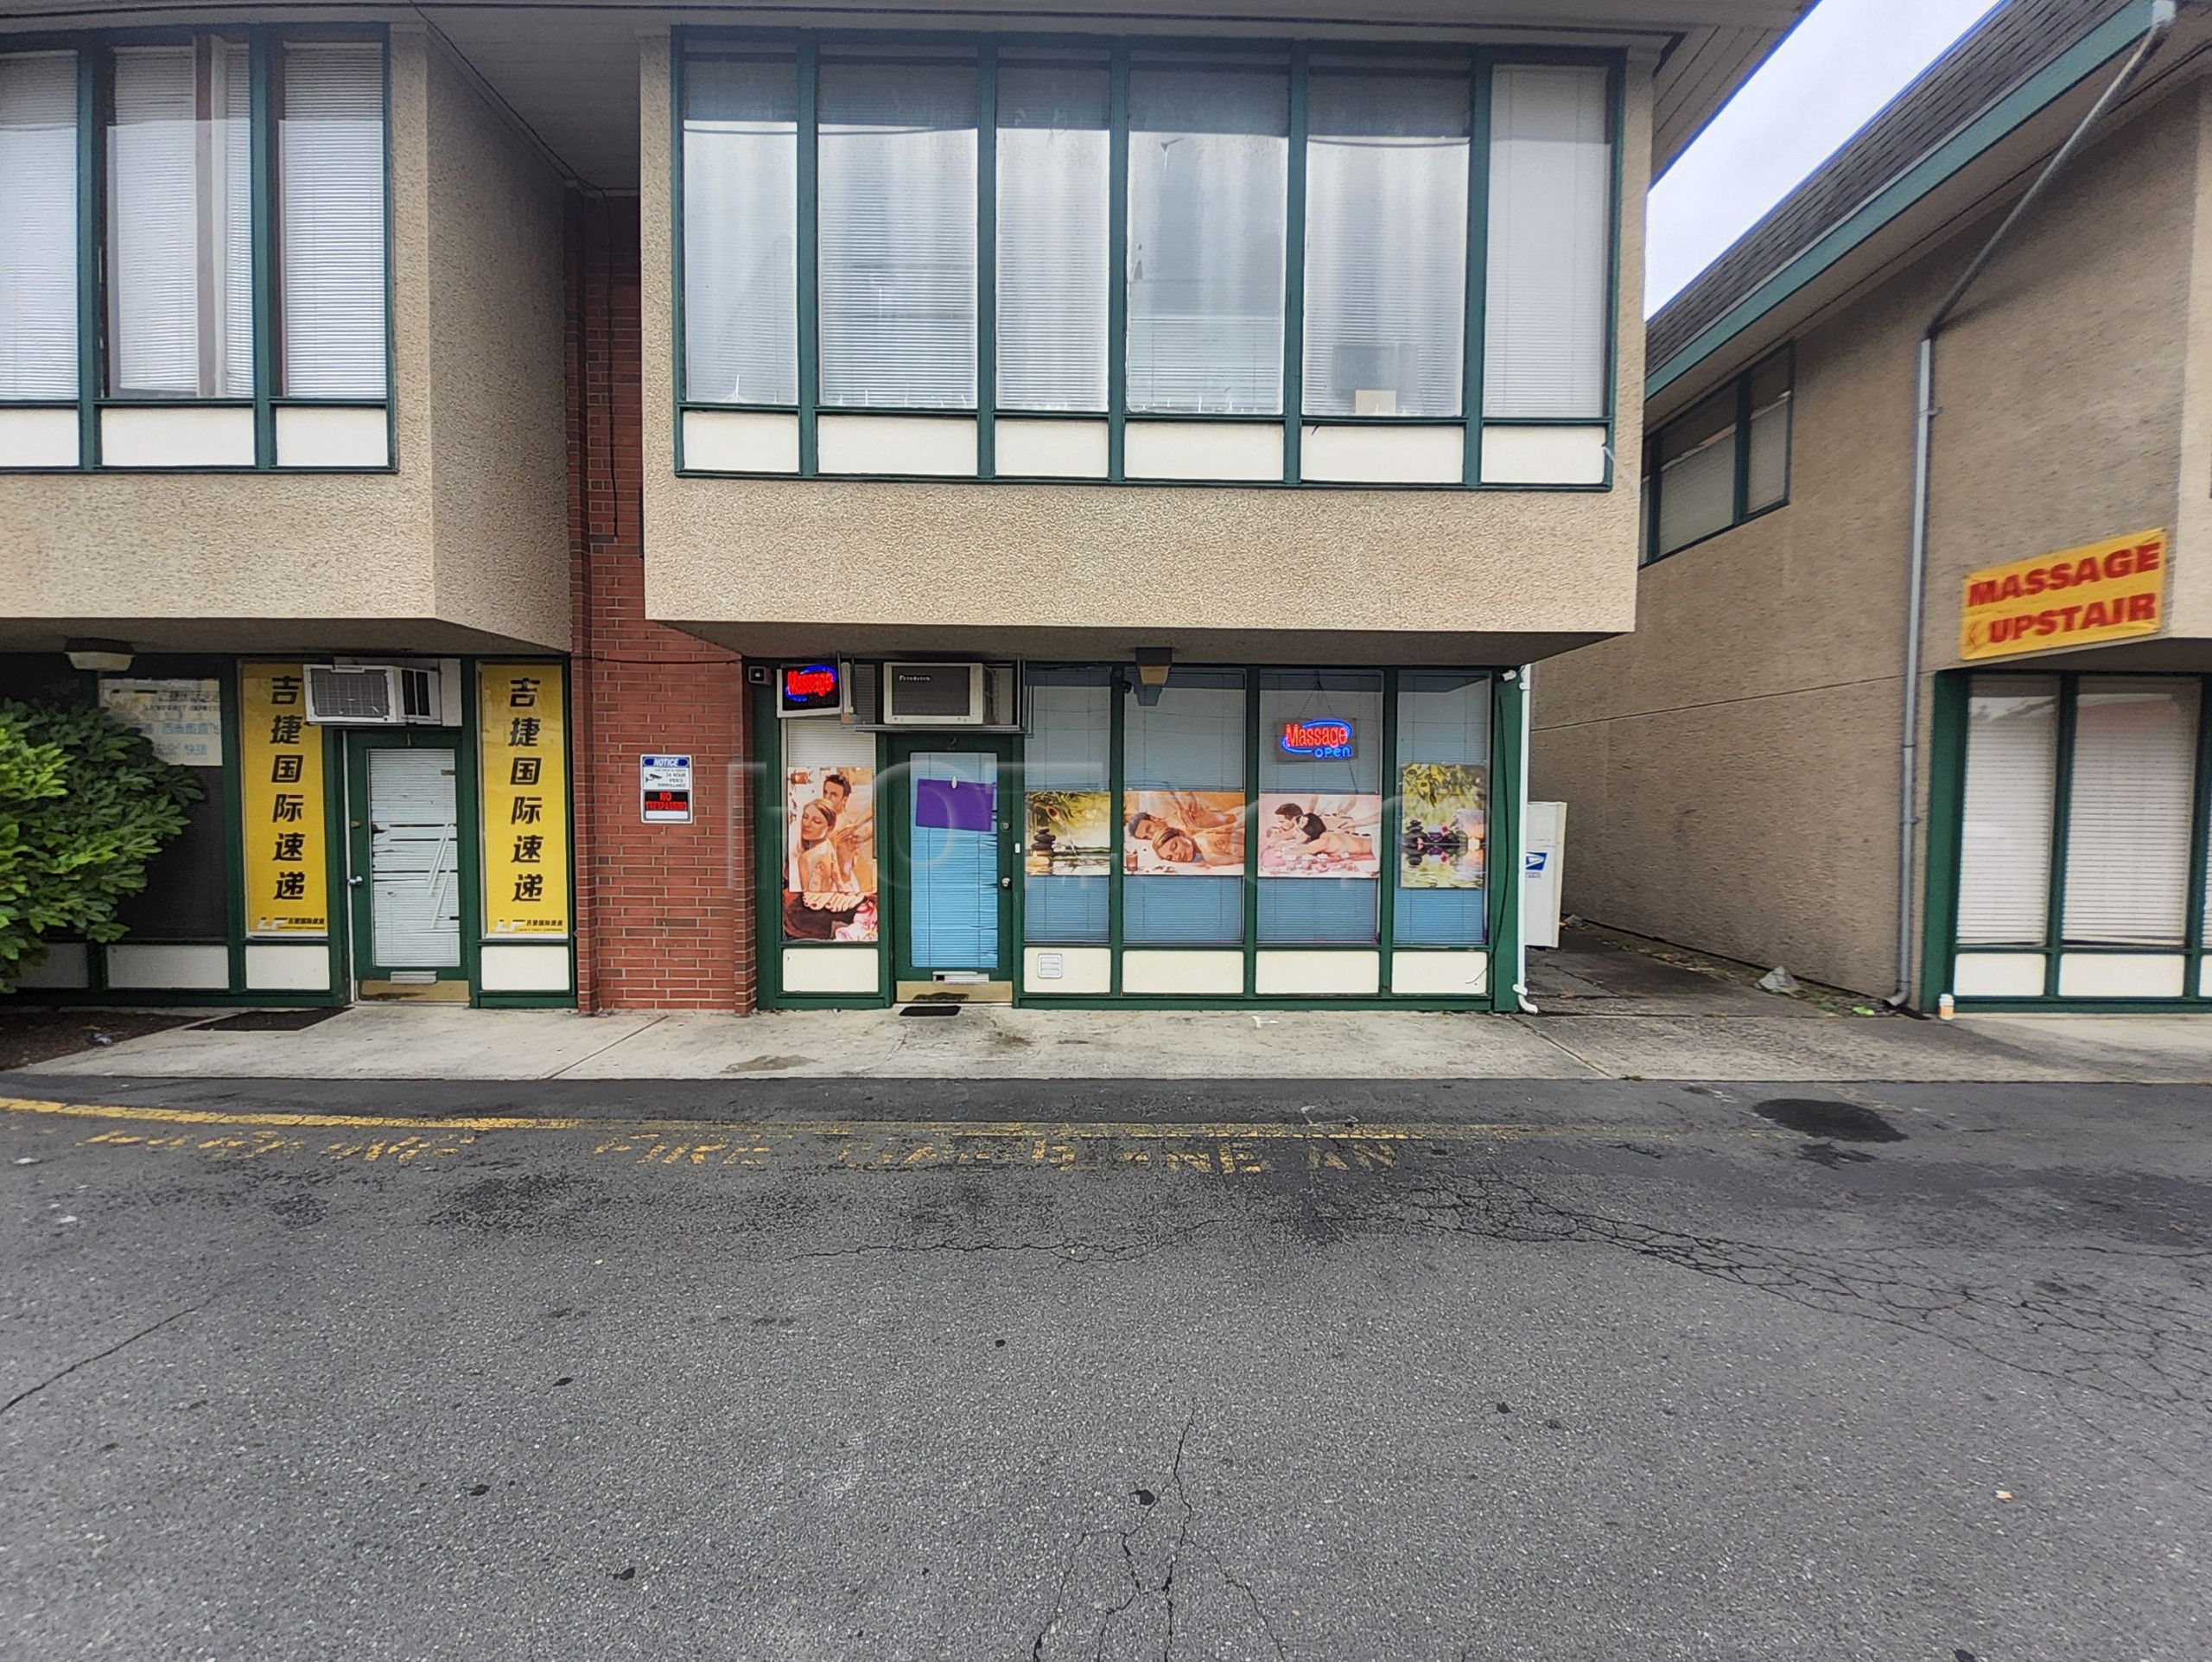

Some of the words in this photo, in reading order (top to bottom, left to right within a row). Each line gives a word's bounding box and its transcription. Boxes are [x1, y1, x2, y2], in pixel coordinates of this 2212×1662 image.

[1968, 542, 2161, 608] MASSAGE
[1989, 592, 2157, 644] UPSTAIR
[1285, 723, 1348, 748] Massage
[270, 675, 305, 901] 吉捷国际速递
[653, 758, 678, 767] NOTICE
[508, 678, 543, 902] 吉捷国际速递
[659, 793, 672, 802] NO
